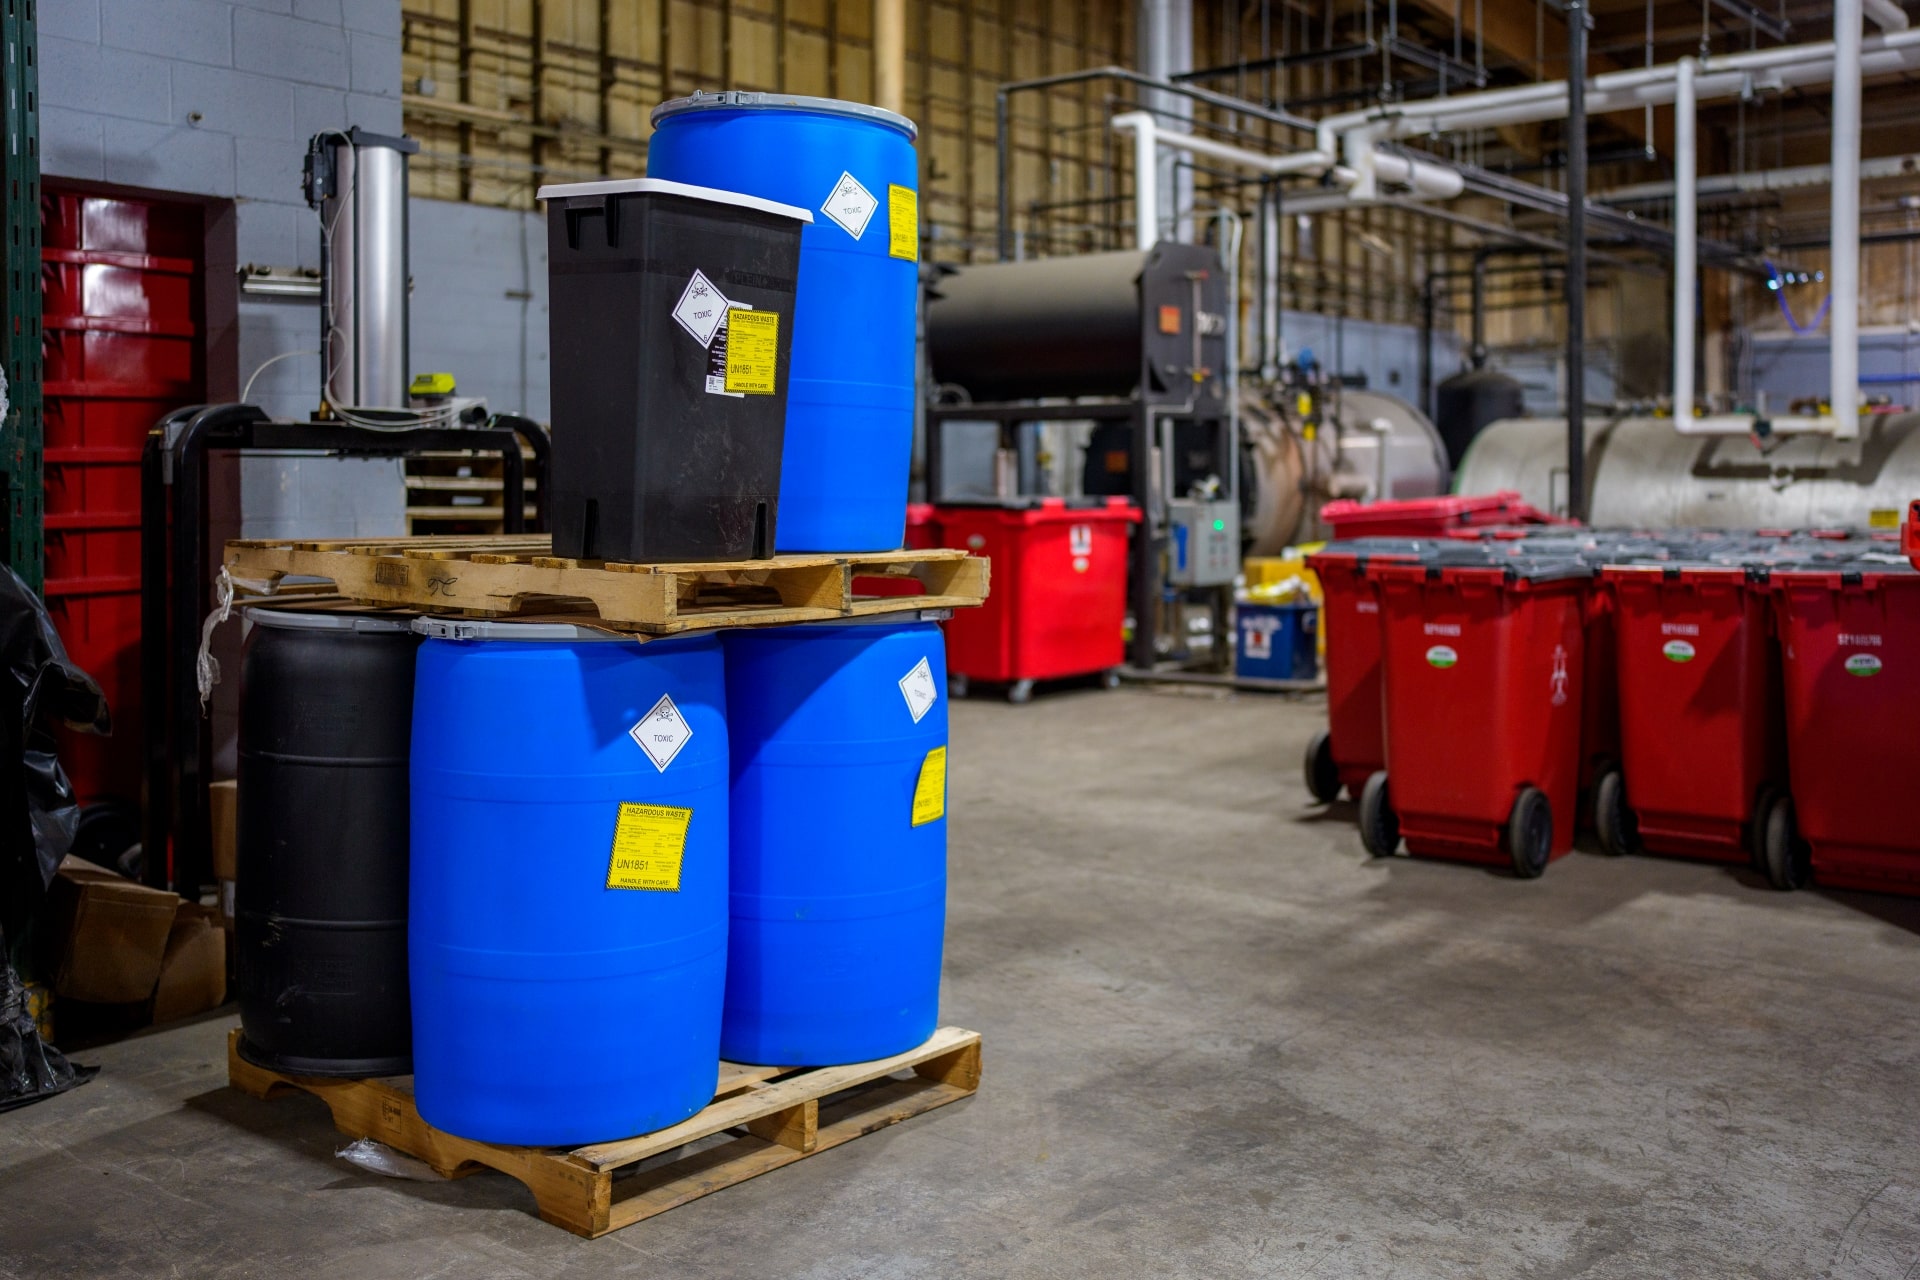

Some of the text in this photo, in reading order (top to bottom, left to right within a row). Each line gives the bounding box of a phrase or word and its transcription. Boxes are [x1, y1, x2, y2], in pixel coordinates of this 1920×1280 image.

[843, 206, 862, 215] TOXIC
[693, 309, 713, 319] TOXIC
[732, 312, 775, 324] HAZARDOUS WASTE
[703, 334, 708, 342] 6
[730, 363, 752, 375] UN1851
[653, 734, 674, 743] TOXIC
[659, 758, 664, 766] 6
[626, 806, 665, 817] HAZARDOUS
[665, 810, 686, 819] WASTE
[616, 858, 649, 871] UN1851
